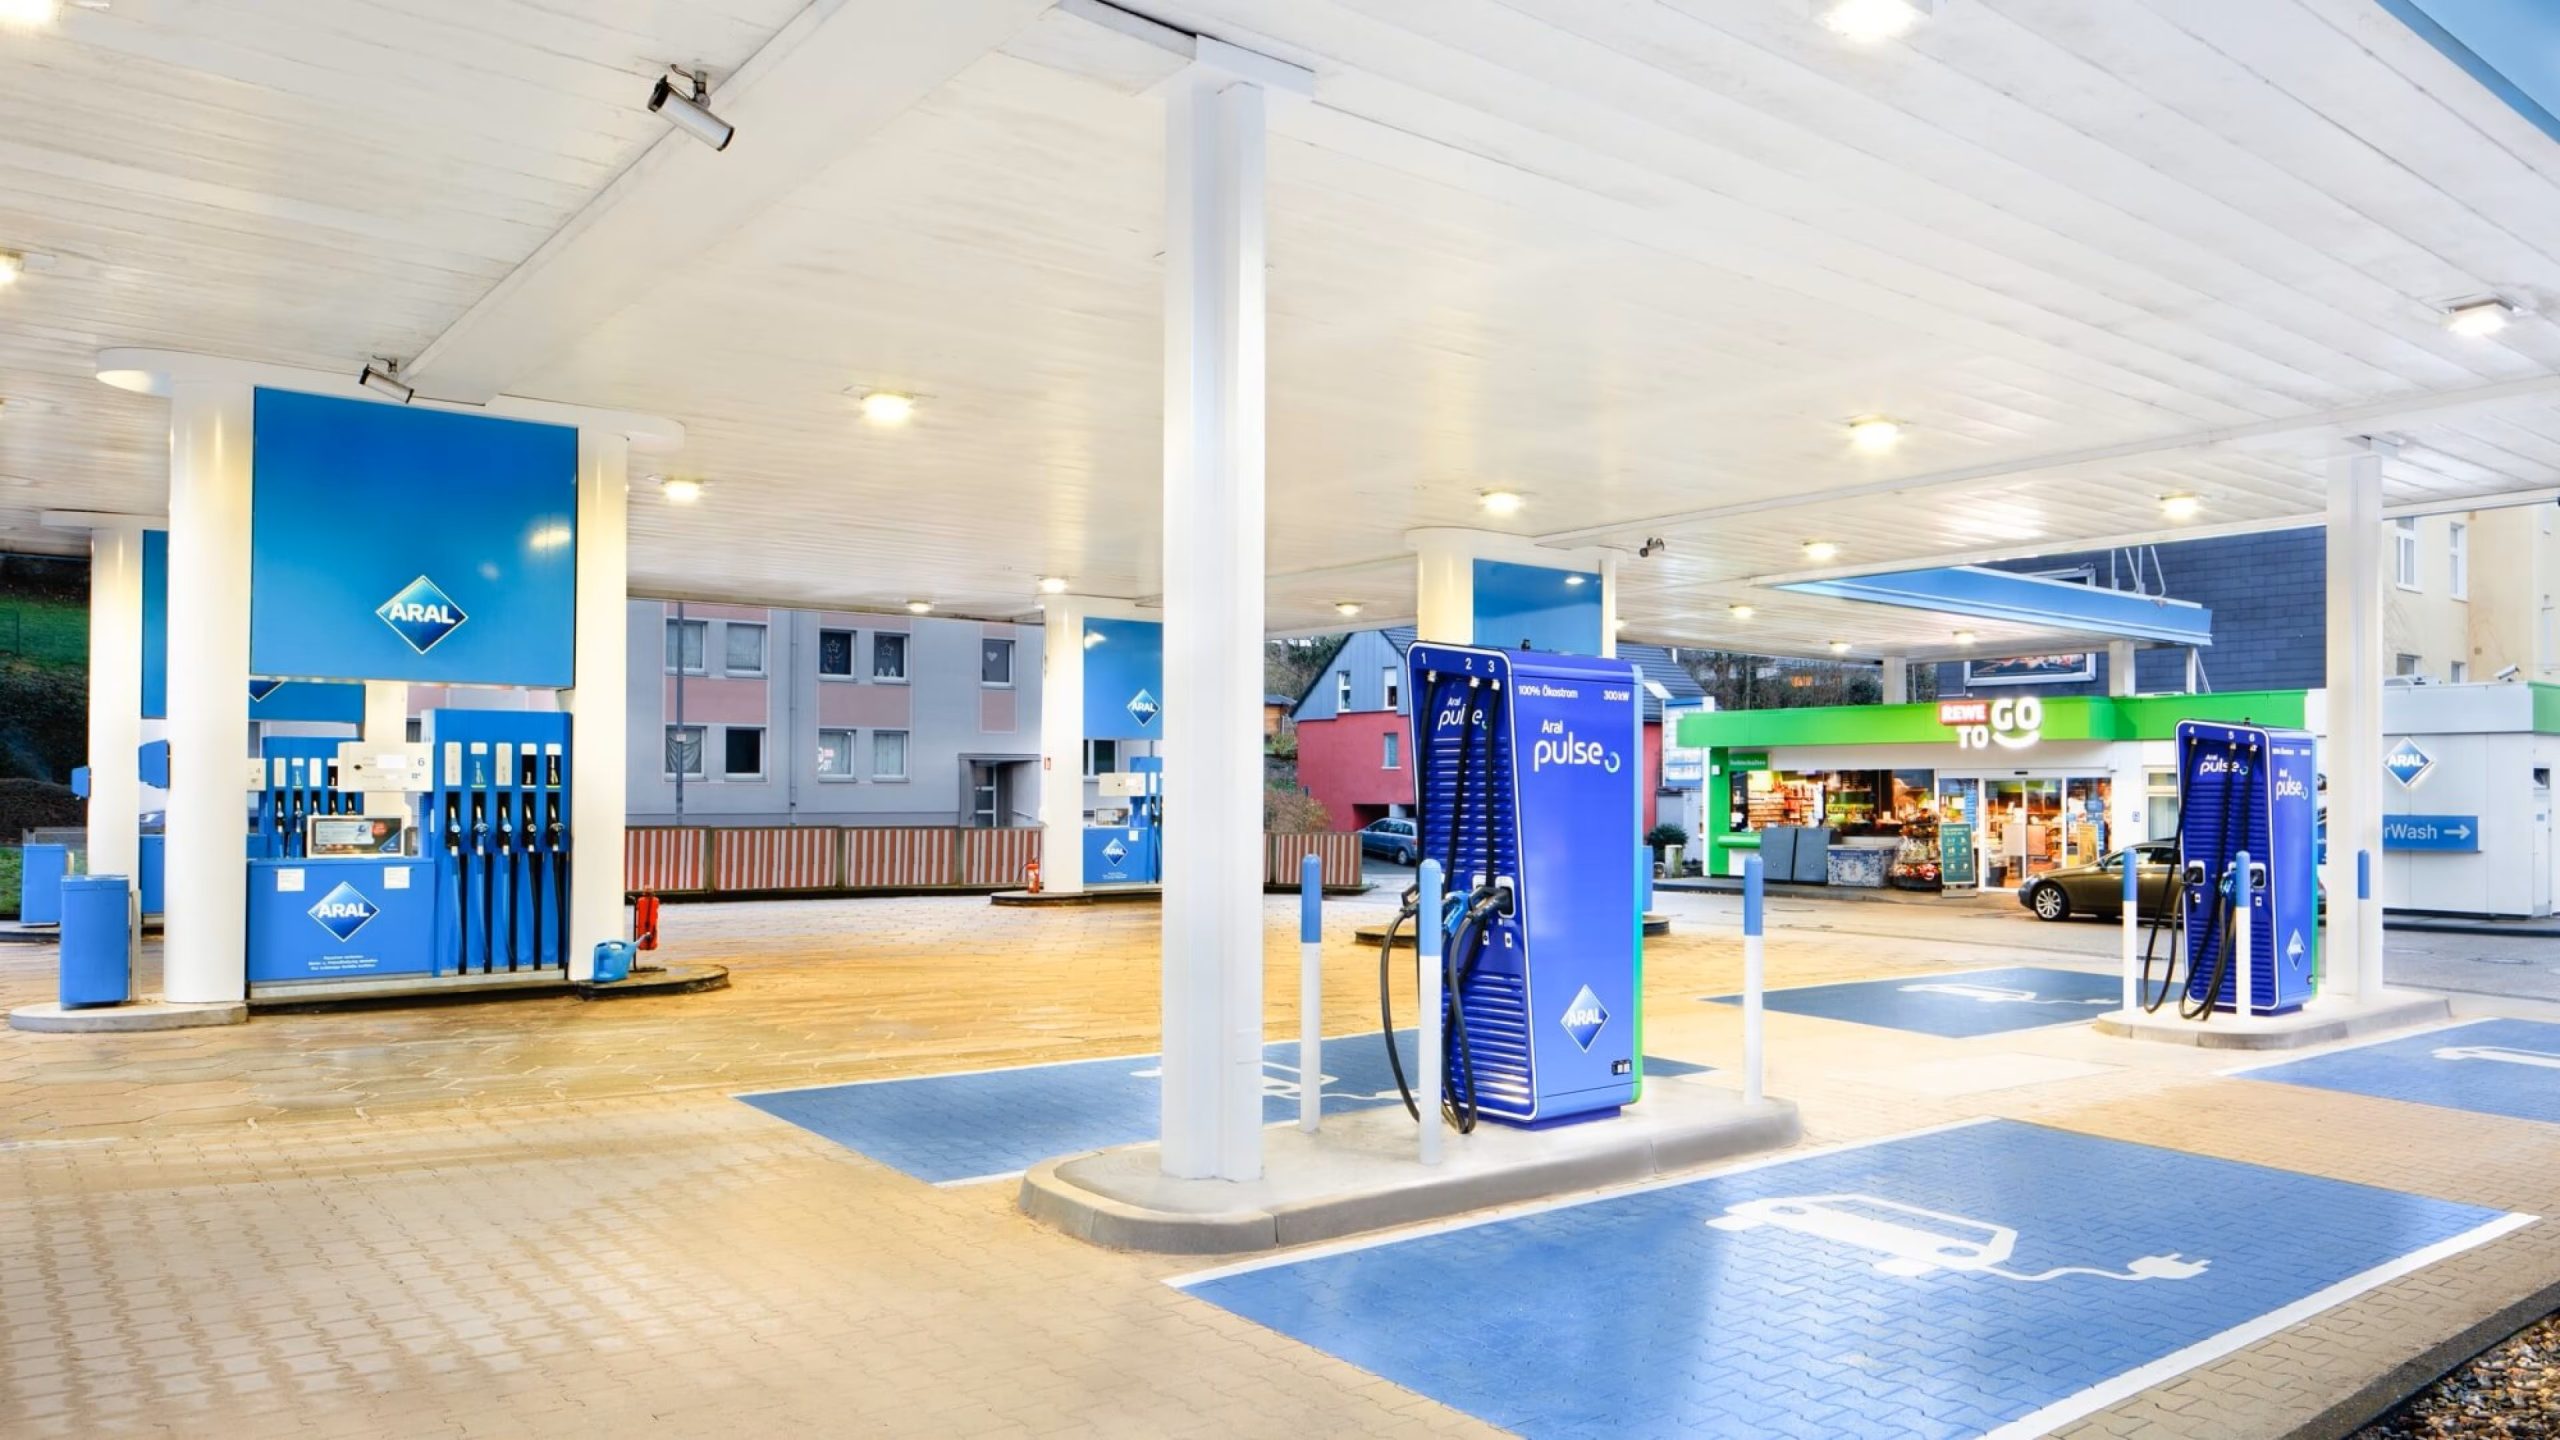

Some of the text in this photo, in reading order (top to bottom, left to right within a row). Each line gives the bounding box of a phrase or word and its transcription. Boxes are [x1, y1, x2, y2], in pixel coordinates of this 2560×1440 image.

[388, 603, 456, 624] ARAL
[1421, 652, 1427, 664] 1
[1465, 658, 1472, 670] 2
[1488, 660, 1495, 673] 3
[1518, 684, 1578, 698] 100% Ökostrom
[1131, 701, 1156, 712] ARAL
[1447, 697, 1462, 707] Aral
[1438, 704, 1482, 731] pule
[1942, 704, 1985, 720] REWE
[1991, 697, 2041, 731] GO
[1541, 719, 1563, 734] Aral
[2188, 726, 2195, 734] 4
[1956, 725, 1989, 749] TO
[2228, 731, 2234, 740] 5
[2248, 733, 2255, 742] 6
[1534, 731, 1603, 772] pulse
[417, 757, 425, 767] 6
[2387, 754, 2424, 767] ARAL
[2276, 776, 2302, 801] pulse
[2384, 823, 2438, 840] rWash
[317, 903, 370, 918] ARAL
[1566, 1009, 1603, 1027] ARAL
